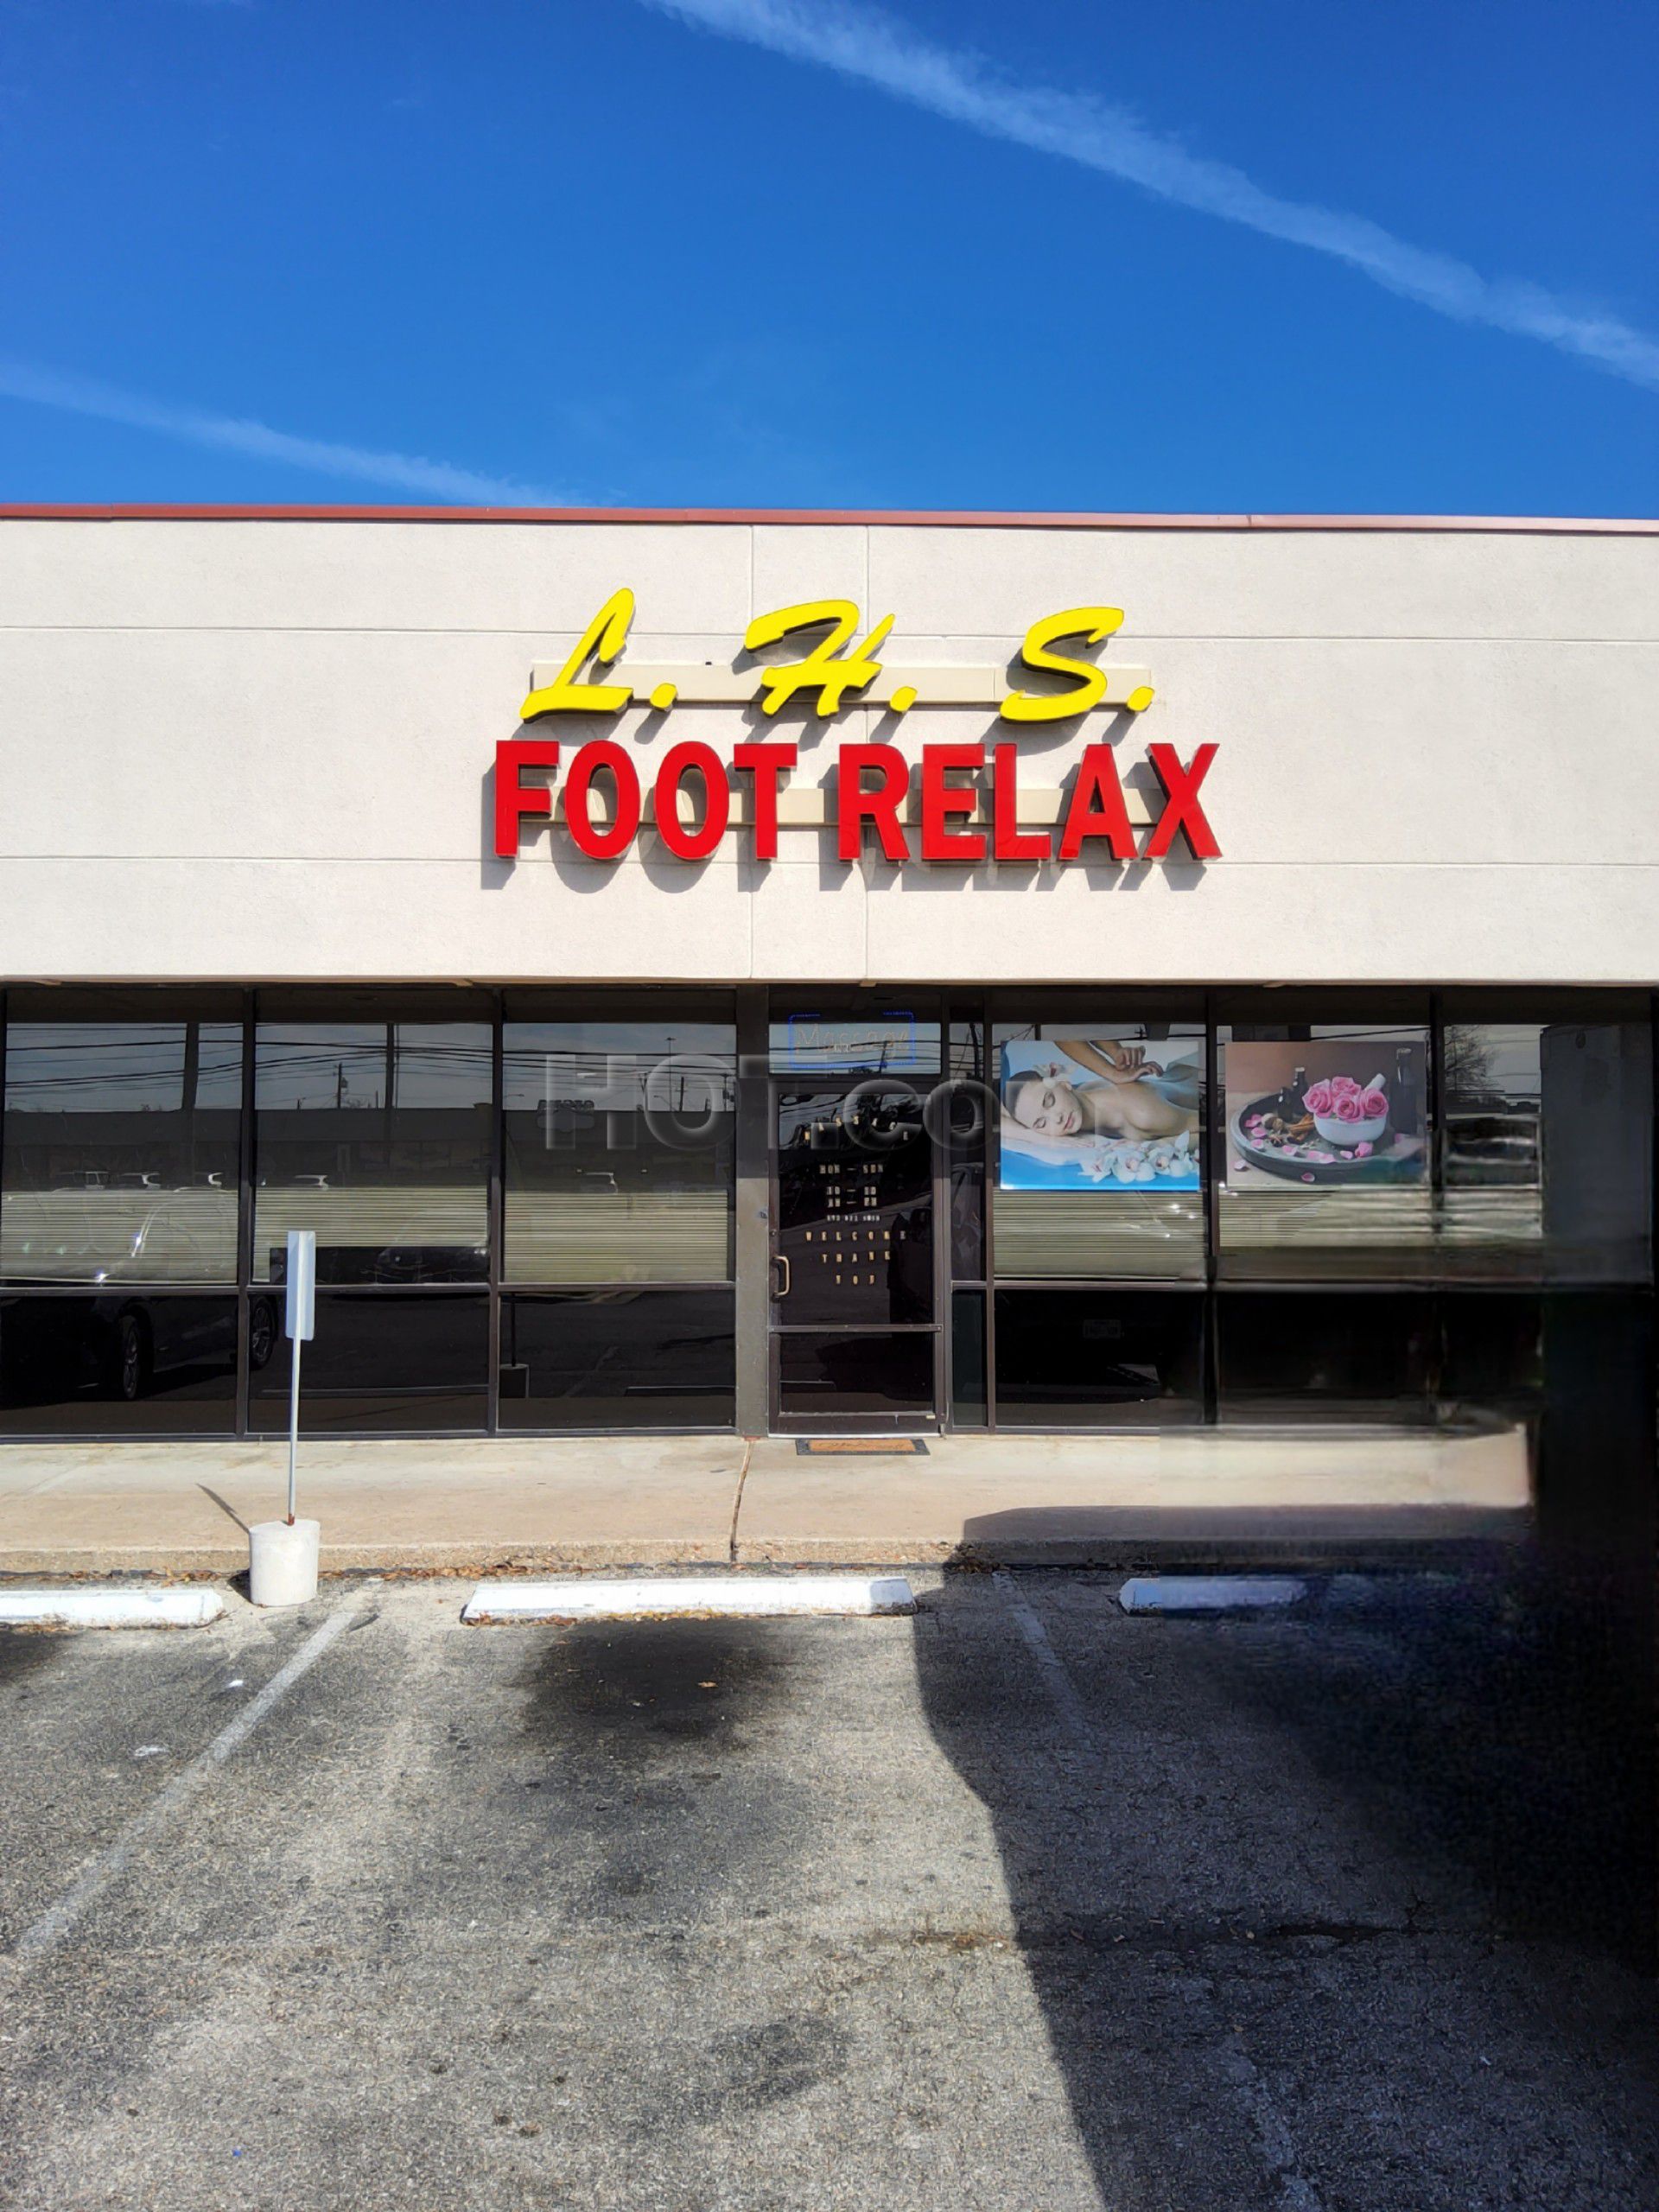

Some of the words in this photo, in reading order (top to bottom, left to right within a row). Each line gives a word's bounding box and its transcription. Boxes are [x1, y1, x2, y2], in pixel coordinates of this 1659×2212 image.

[494, 740, 798, 861] FOOT
[837, 741, 1223, 861] RELAX
[794, 1023, 910, 1058] Massage
[805, 1230, 906, 1242] WELCOME
[822, 1250, 891, 1263] THANK
[836, 1274, 875, 1285] YOU
